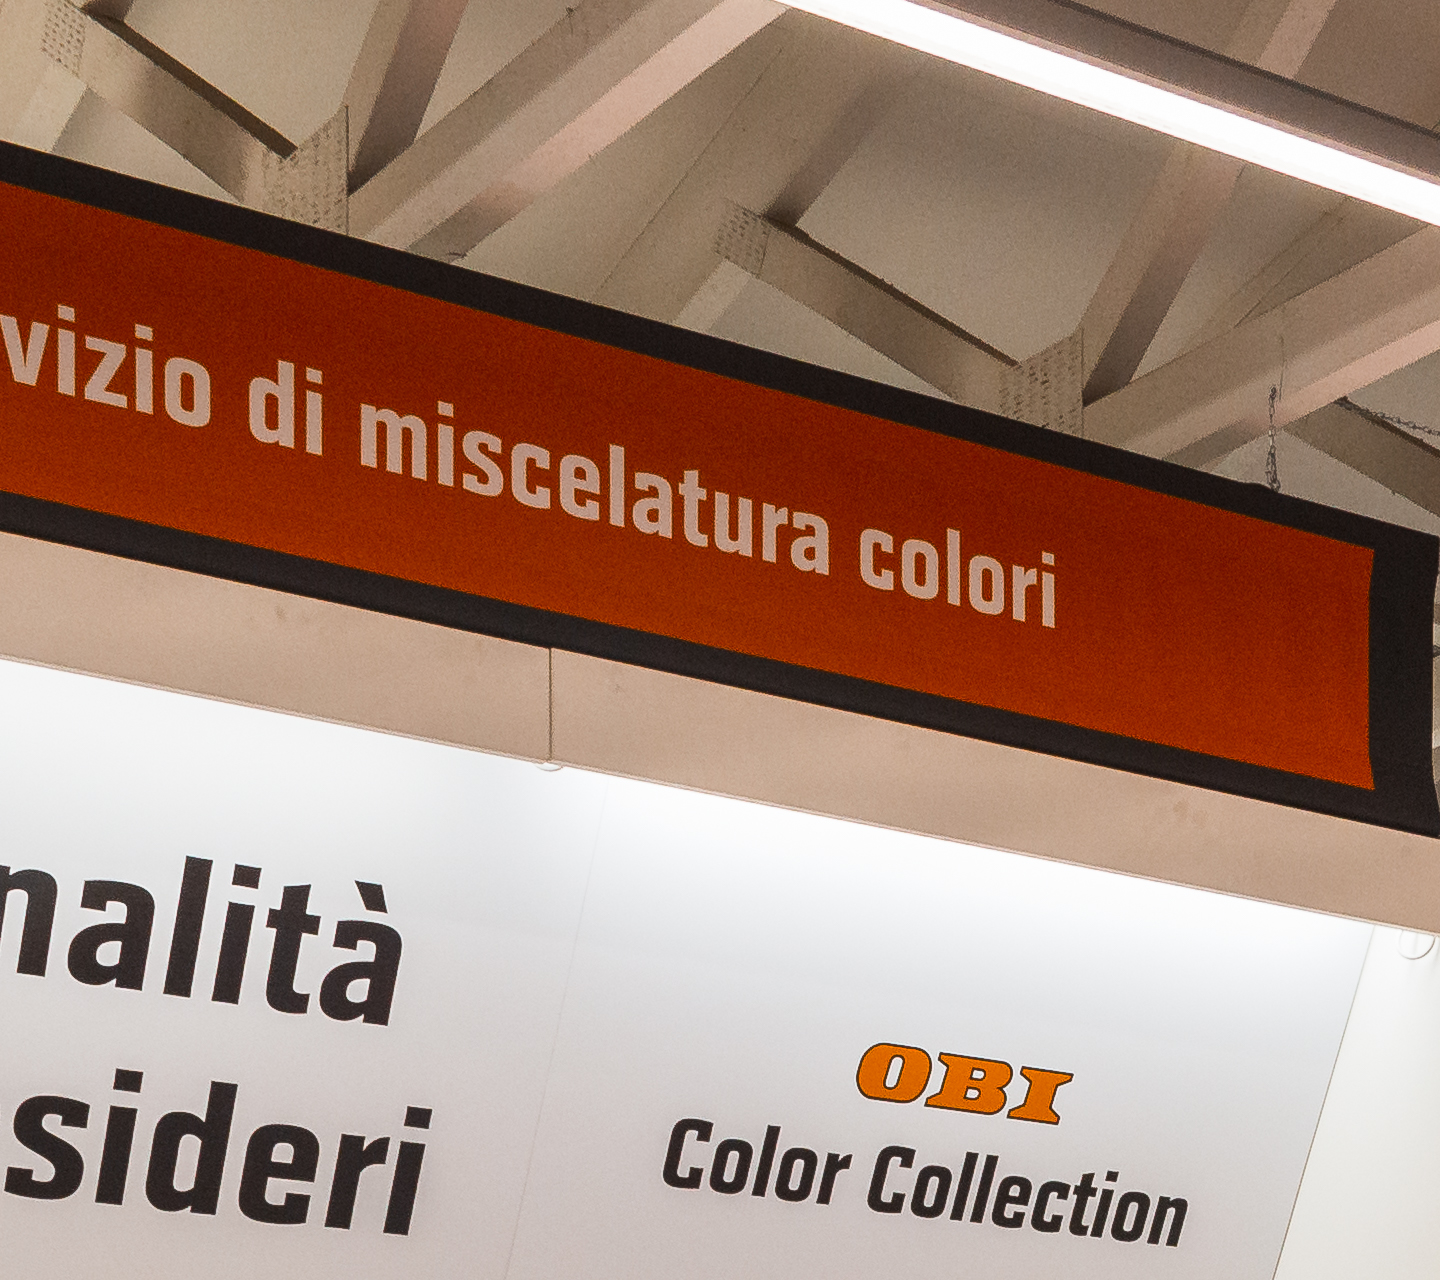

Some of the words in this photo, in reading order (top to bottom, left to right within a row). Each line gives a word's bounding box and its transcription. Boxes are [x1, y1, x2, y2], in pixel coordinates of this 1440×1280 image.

[248, 359, 324, 456] di
[360, 400, 831, 575] miscelatura
[858, 524, 1057, 628] colori
[856, 1042, 1074, 1125] OBI
[662, 1117, 853, 1205] Color
[867, 1145, 1189, 1247] Collection
